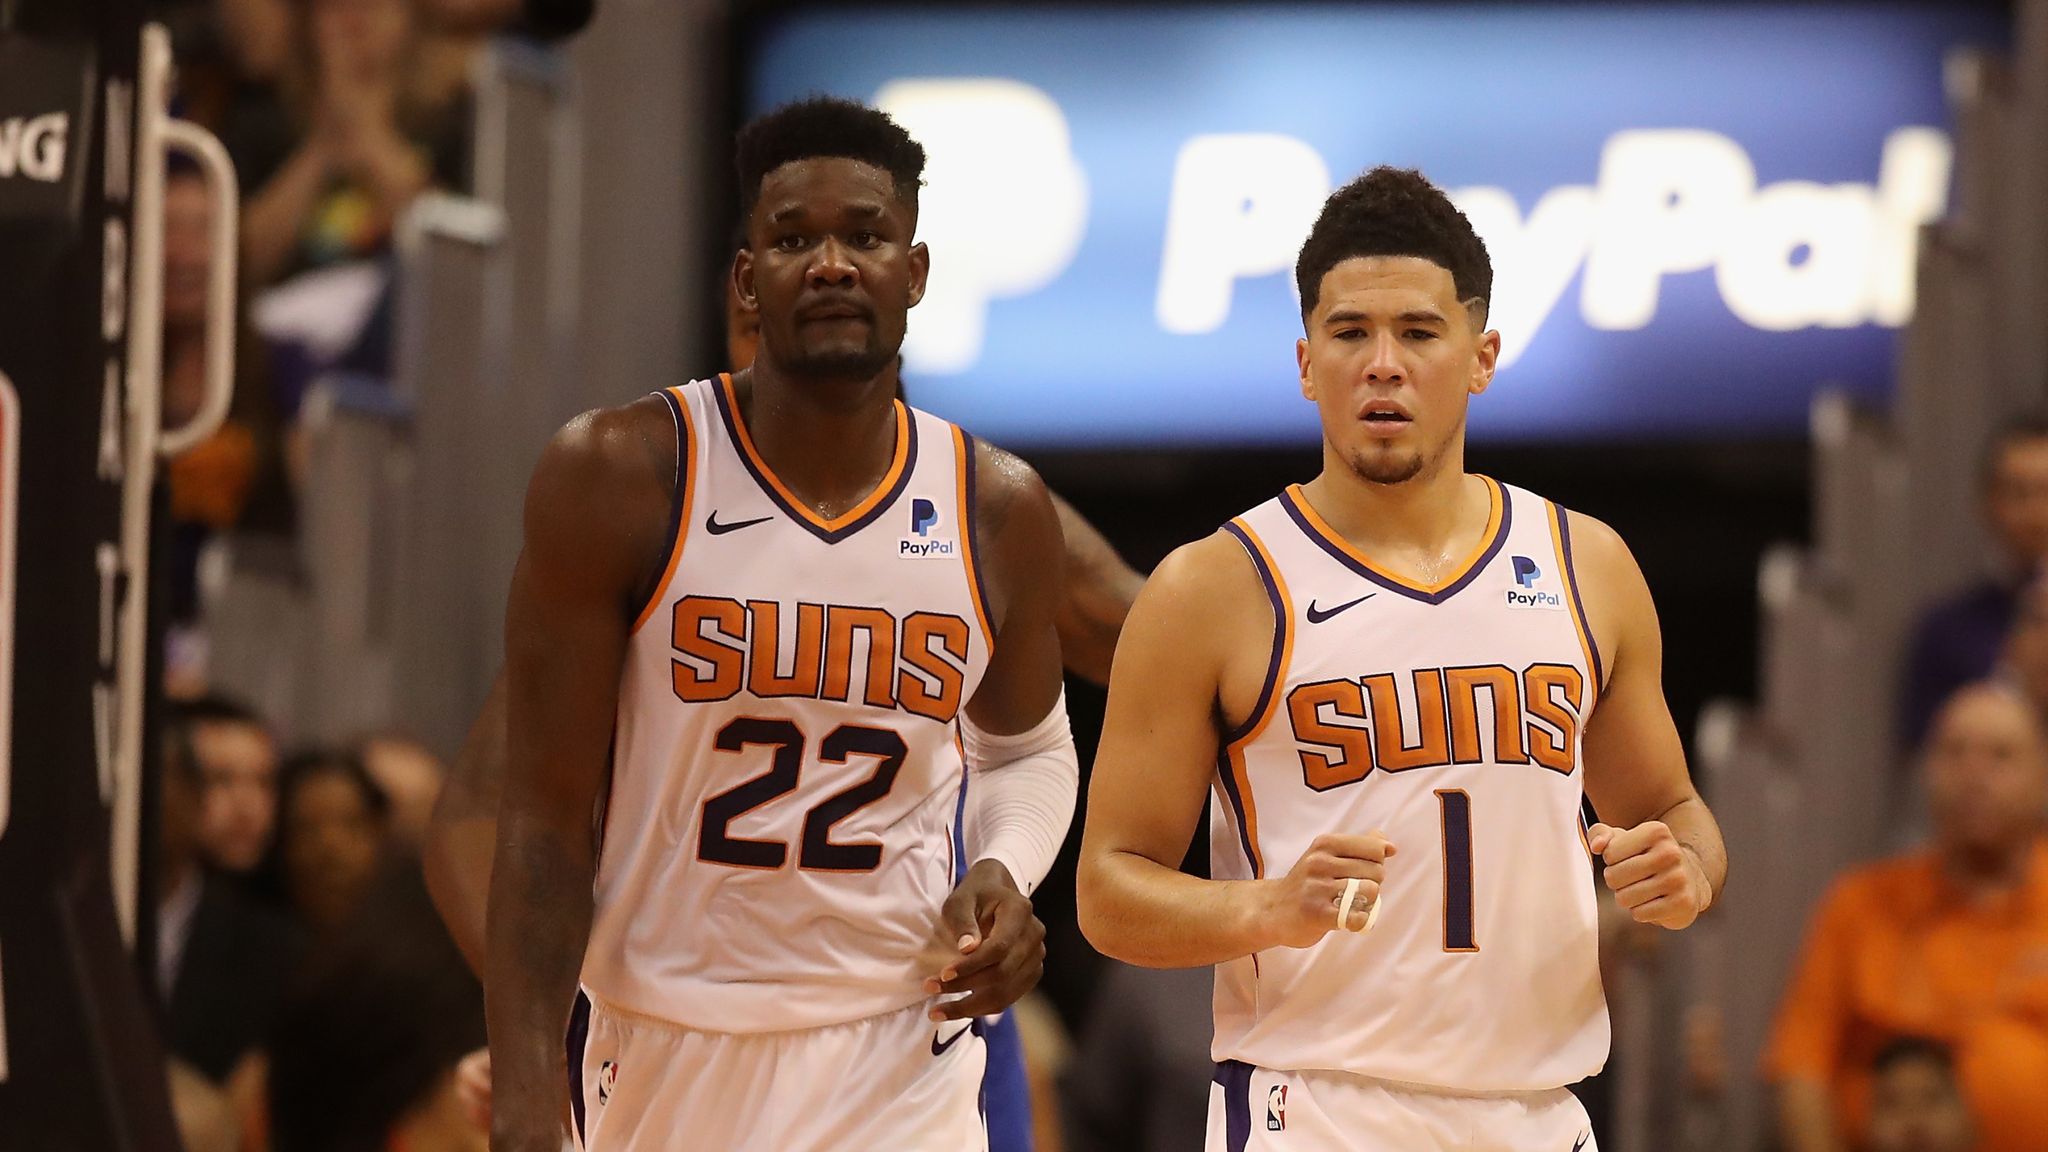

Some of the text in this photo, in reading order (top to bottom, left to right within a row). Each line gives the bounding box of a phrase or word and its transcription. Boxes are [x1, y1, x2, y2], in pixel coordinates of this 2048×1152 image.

[1155, 126, 1953, 370] PyPal
[900, 540, 953, 556] PayPal
[1507, 591, 1560, 606] PayPal
[671, 595, 969, 723] SUNS
[1286, 663, 1583, 792] SUNS
[696, 717, 908, 873] 22
[1433, 788, 1480, 952] 1
